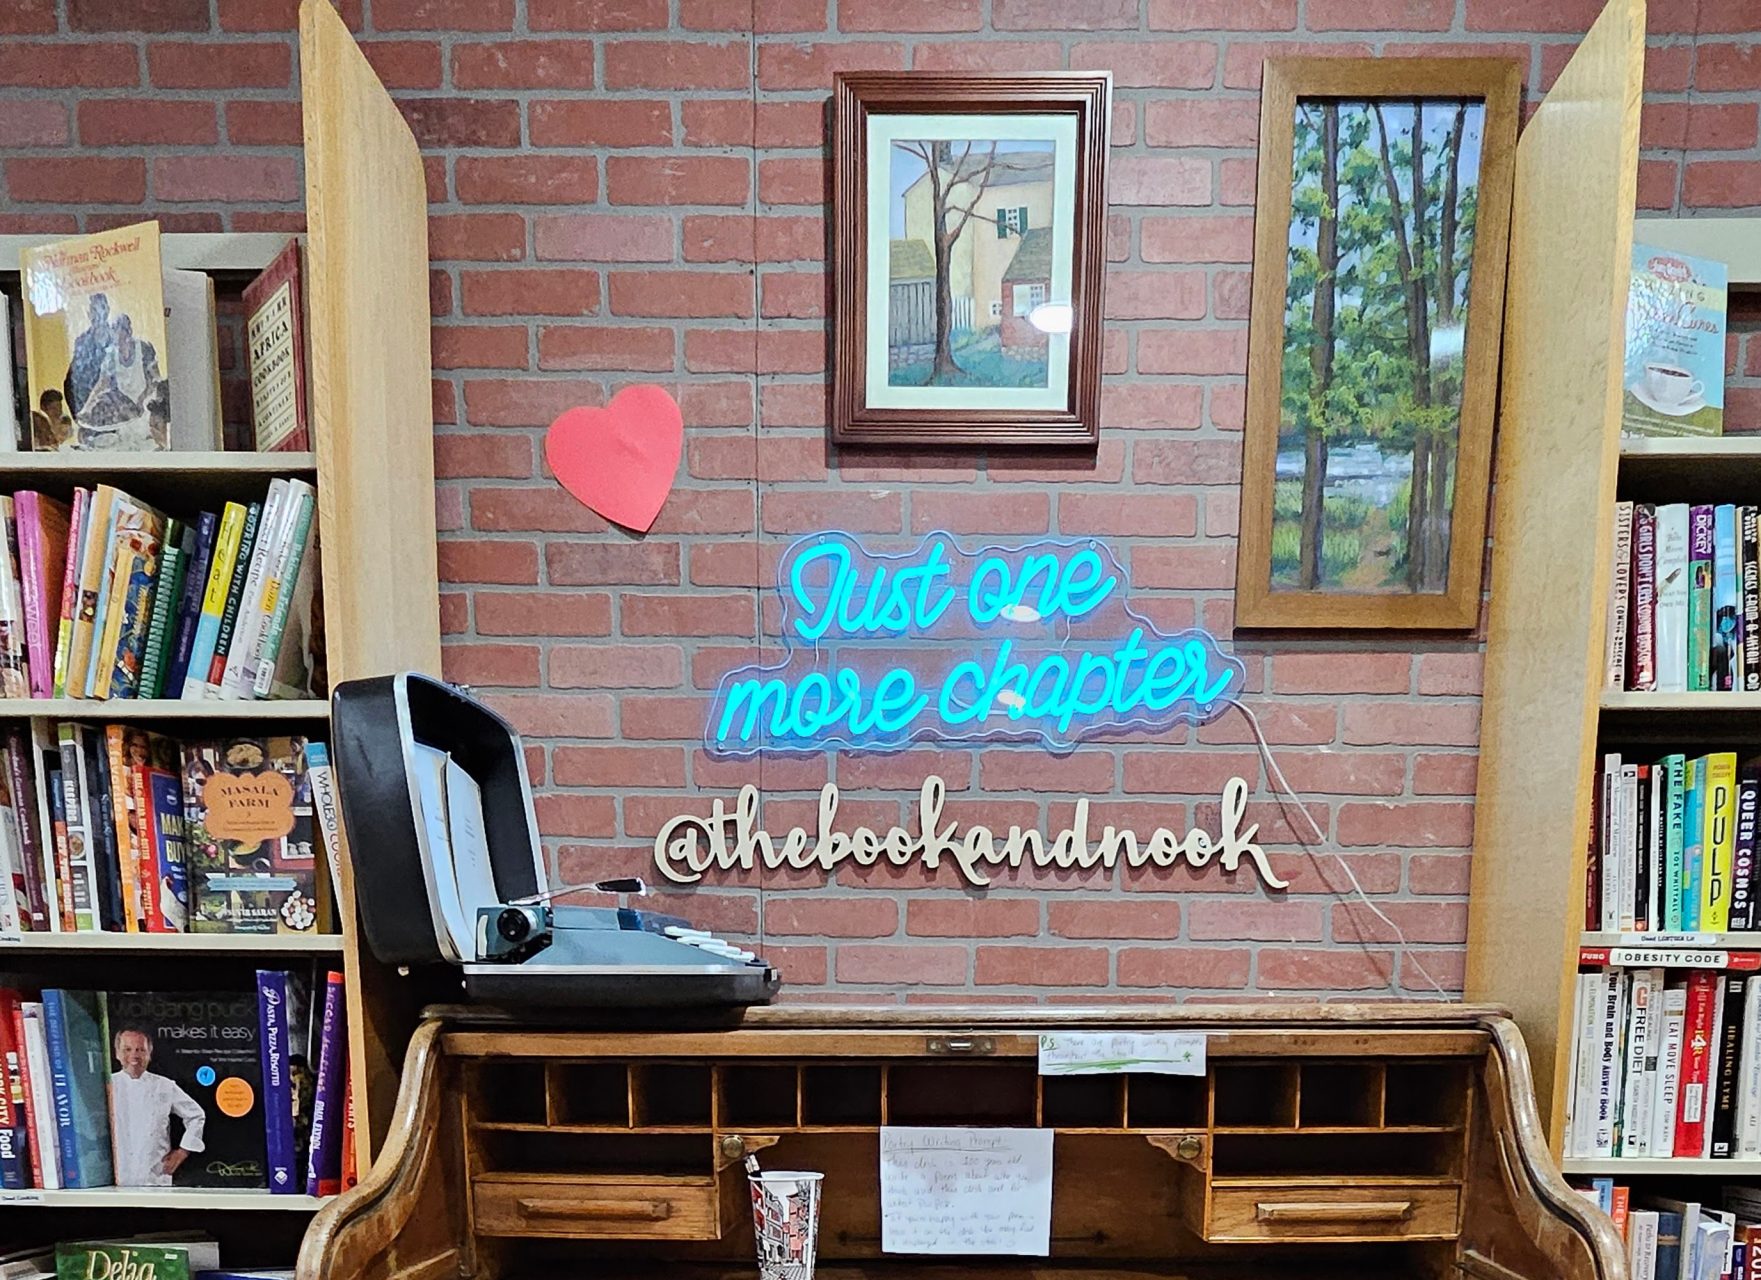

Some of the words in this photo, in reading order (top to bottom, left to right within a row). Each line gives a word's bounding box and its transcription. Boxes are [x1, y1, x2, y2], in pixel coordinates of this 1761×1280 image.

[253, 321, 288, 362] AFRICA
[254, 347, 290, 388] COOKBOOK
[239, 502, 260, 559] COOKING
[1619, 505, 1630, 549] SISTERS
[1640, 525, 1653, 553] GIRLS
[1696, 515, 1706, 554] DICKEY
[230, 563, 244, 594] WITH
[250, 547, 269, 587] Recipe
[1616, 562, 1629, 601] LOVERS
[1639, 554, 1653, 582] DON'T
[264, 580, 280, 612] Dozen
[792, 539, 956, 640] Just
[970, 544, 1118, 623] one
[218, 597, 235, 655] CHILDREN
[716, 670, 929, 743] more
[939, 627, 1235, 733] chapter
[111, 749, 123, 822] favorites
[1674, 760, 1684, 787] THE
[65, 780, 78, 822] KEEPERS
[221, 785, 279, 797] MASALA
[228, 799, 269, 809] FARM
[317, 772, 338, 832] WHOLE30
[1674, 794, 1683, 830] FAKE
[1740, 790, 1756, 841] QUEER
[654, 775, 1290, 891] @thebookandnook
[1711, 787, 1726, 907] PULP
[1735, 848, 1752, 910] COSMOS
[1625, 953, 1680, 963] OBESITY
[1685, 955, 1720, 963] CODE
[1609, 971, 1620, 993] Your
[112, 999, 199, 1021] wolfgang
[208, 999, 256, 1021] puck
[263, 986, 281, 1026] PASTA,
[1607, 995, 1618, 1019] Brain
[157, 1024, 207, 1039] makes
[211, 1024, 218, 1039] it
[221, 1026, 256, 1042] easy
[268, 1027, 278, 1053] PIZZA,
[1606, 1022, 1617, 1038] and
[1635, 1007, 1647, 1043] FREE
[1669, 1022, 1679, 1038] EAT
[1603, 1041, 1614, 1062] Body
[1633, 1046, 1644, 1076] DIET
[1666, 1043, 1678, 1069] MOVE
[1725, 1025, 1736, 1076] HEALING
[271, 1053, 281, 1086] RISOTTO
[1601, 1065, 1612, 1096] Answer
[55, 1073, 71, 1127] FLAVOR
[1665, 1074, 1675, 1104] SLEEP
[1722, 1081, 1733, 1111] LYME
[1600, 1099, 1610, 1121] Book
[0, 1129, 15, 1159] Food
[883, 1134, 914, 1153] Poetry
[922, 1134, 961, 1148] Writing
[1616, 1195, 1624, 1214] THE
